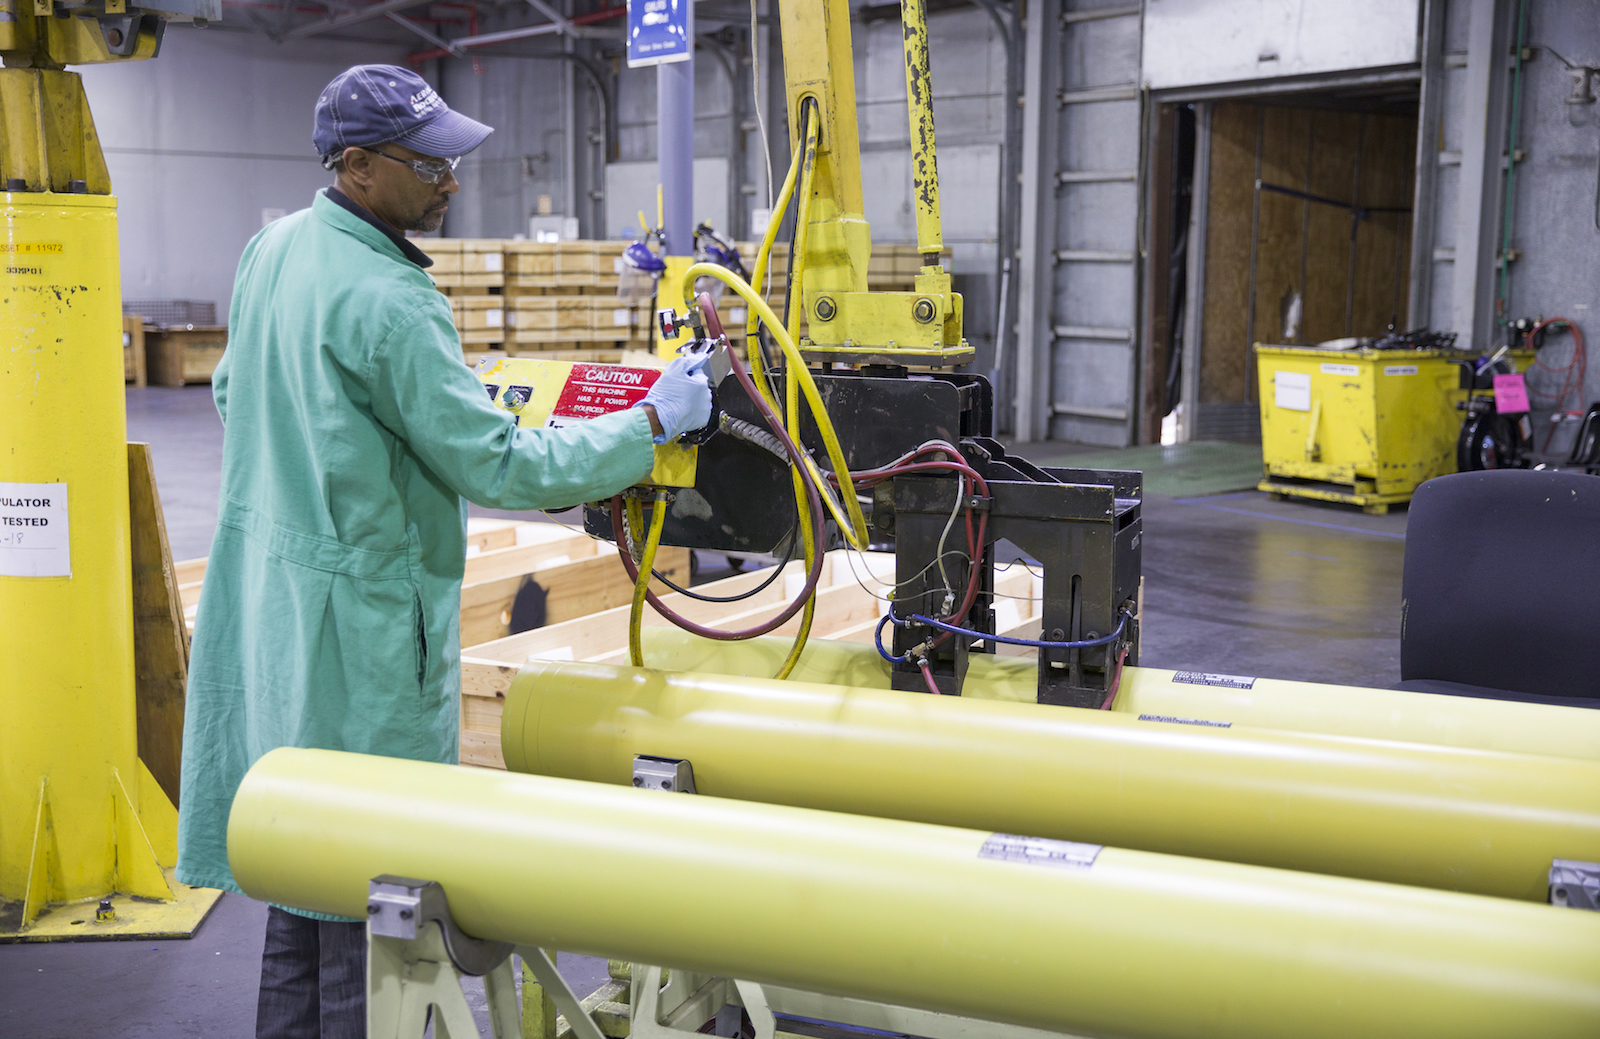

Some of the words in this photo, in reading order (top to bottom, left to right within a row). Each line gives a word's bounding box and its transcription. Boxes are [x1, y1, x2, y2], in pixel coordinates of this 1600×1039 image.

[37, 244, 63, 252] 11972
[585, 369, 643, 384] CAUTION
[582, 386, 597, 394] THIS
[597, 387, 627, 396] MACHINE
[577, 395, 592, 403] HAS
[594, 396, 601, 404] 2
[604, 397, 628, 406] POWER
[573, 404, 605, 414] SOURCES
[0, 498, 51, 507] ULATOR
[2, 517, 48, 526] TESTED
